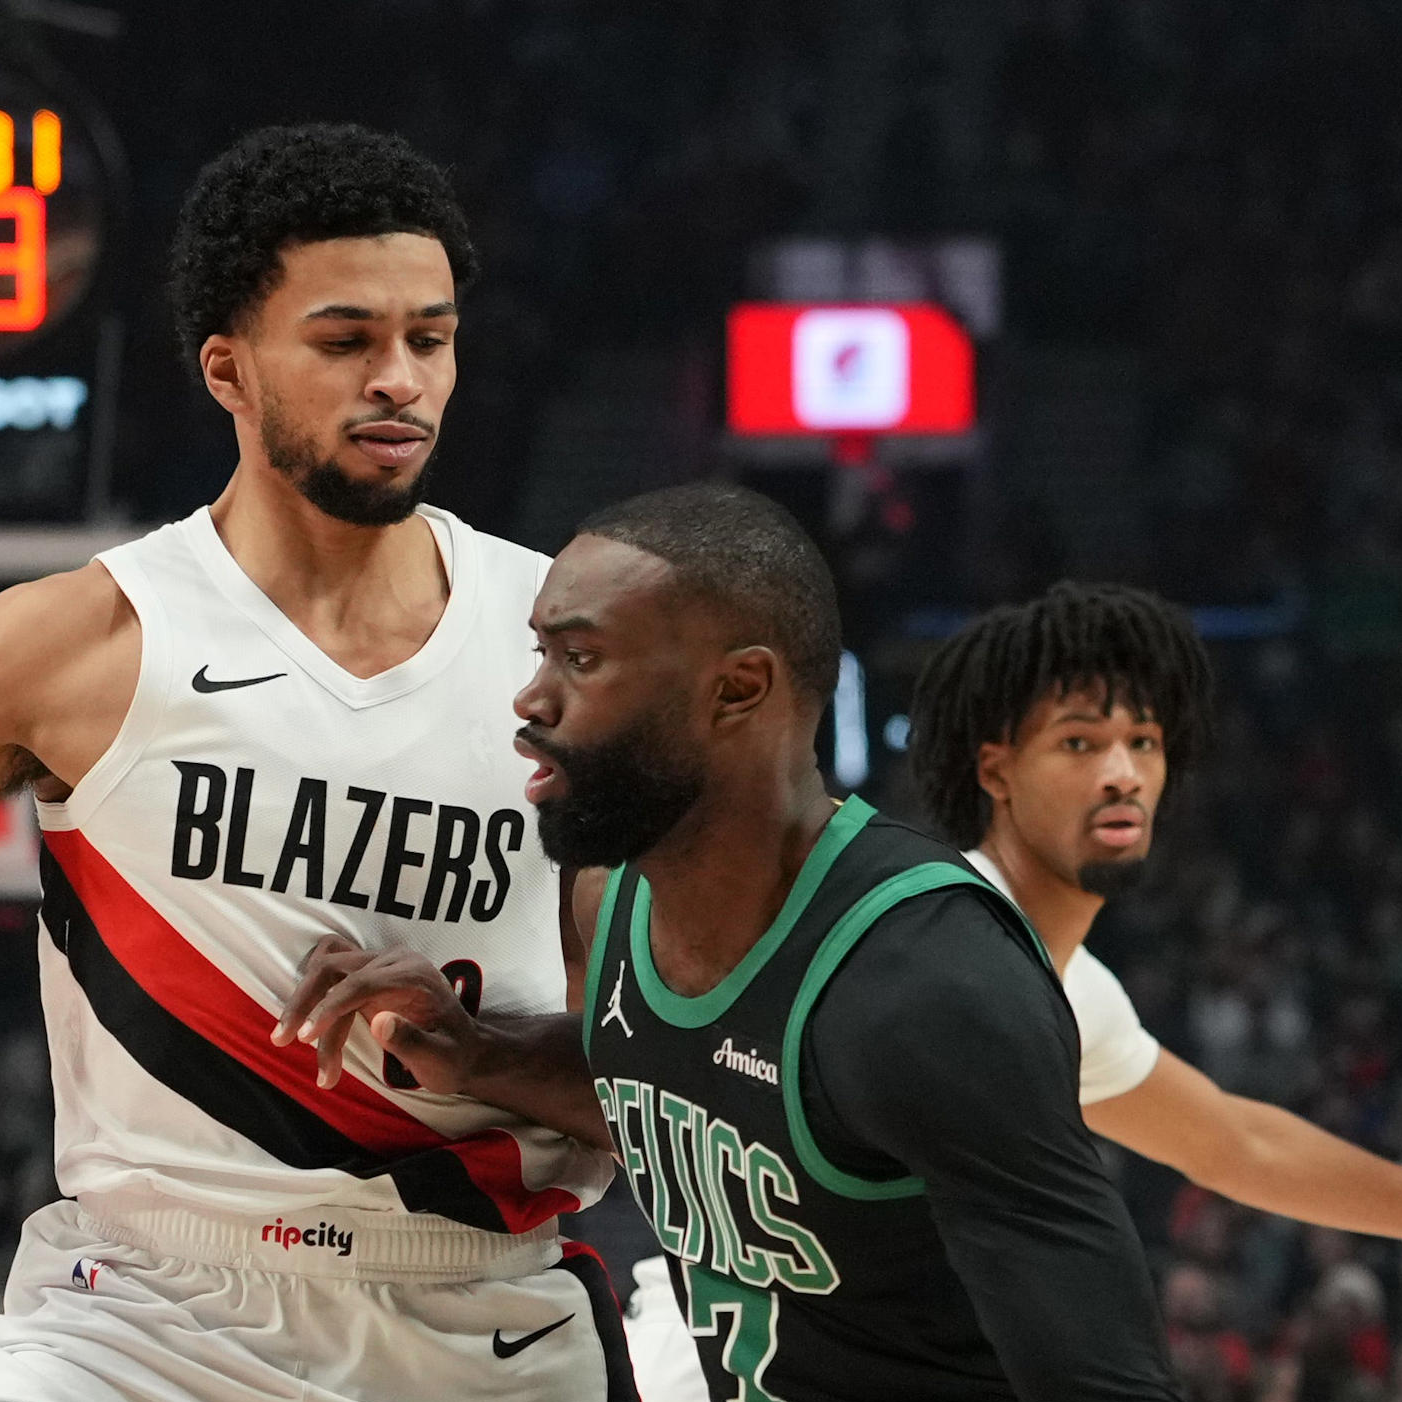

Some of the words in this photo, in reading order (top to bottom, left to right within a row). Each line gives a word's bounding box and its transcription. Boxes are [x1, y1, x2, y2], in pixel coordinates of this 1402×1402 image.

[170, 760, 525, 923] BLAZERS
[713, 1037, 780, 1086] Amica
[261, 1217, 354, 1257] ripcity
